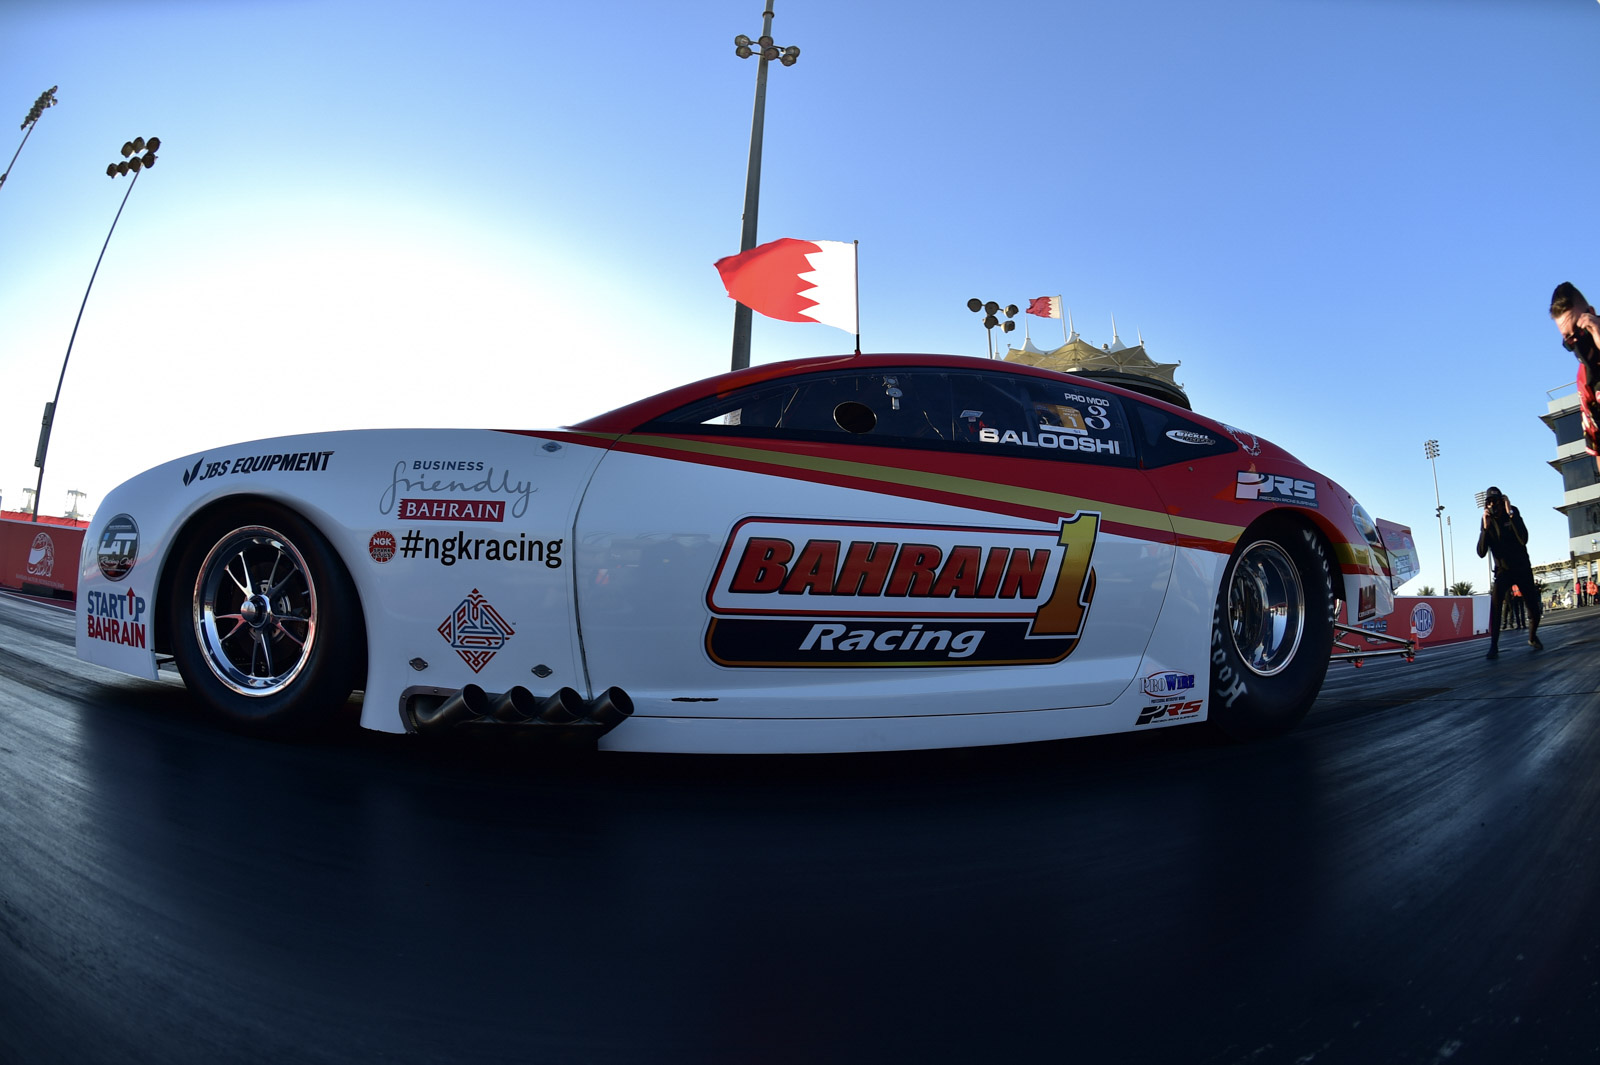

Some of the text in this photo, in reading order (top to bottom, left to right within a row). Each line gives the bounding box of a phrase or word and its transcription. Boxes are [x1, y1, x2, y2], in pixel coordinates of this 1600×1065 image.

[1064, 392, 1110, 407] PRO MOD
[1084, 405, 1111, 430] 3
[979, 427, 1121, 455] BALOOSHI
[199, 451, 334, 481] JBS EQUIPMENT
[412, 460, 485, 471] BUSINESS
[379, 460, 539, 519] friendly
[1236, 471, 1316, 500] PRS
[405, 502, 501, 519] BAHRAIN
[98, 532, 138, 556] LAT
[372, 537, 392, 546] NGK
[400, 530, 564, 569] #ngkracing
[728, 511, 1100, 637] BAHRAIN 1
[87, 614, 146, 649] BAHRAIN
[1413, 609, 1433, 631] NHRA
[798, 622, 985, 658] Racing
[1135, 699, 1204, 725] PRS
